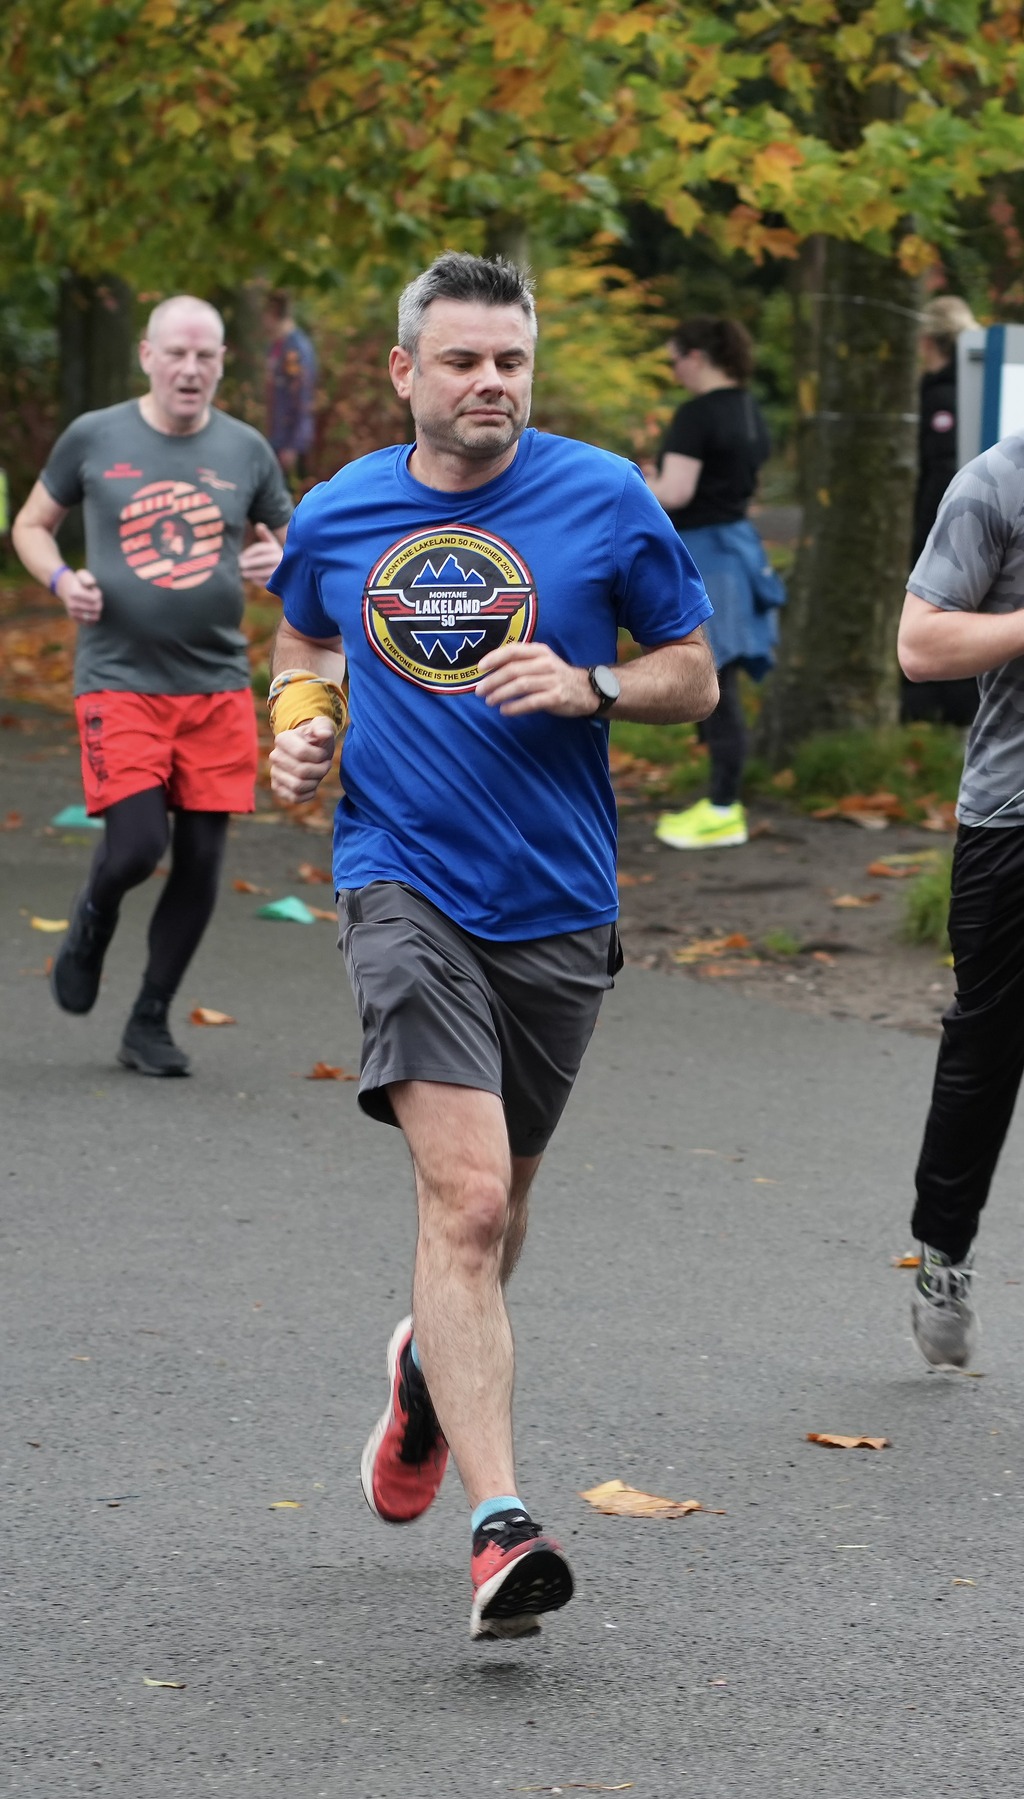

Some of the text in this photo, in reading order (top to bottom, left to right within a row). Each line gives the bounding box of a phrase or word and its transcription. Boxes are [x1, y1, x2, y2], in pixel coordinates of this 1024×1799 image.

[383, 537, 515, 581] MONTANE LAKELAND 50 FINISHER 2024
[429, 591, 468, 599] MONTANE
[415, 599, 481, 615] LAKELAND
[441, 614, 456, 627] 50
[383, 637, 413, 670] EVERYONE
[412, 666, 433, 678] HERE
[460, 668, 479, 679] BEST
